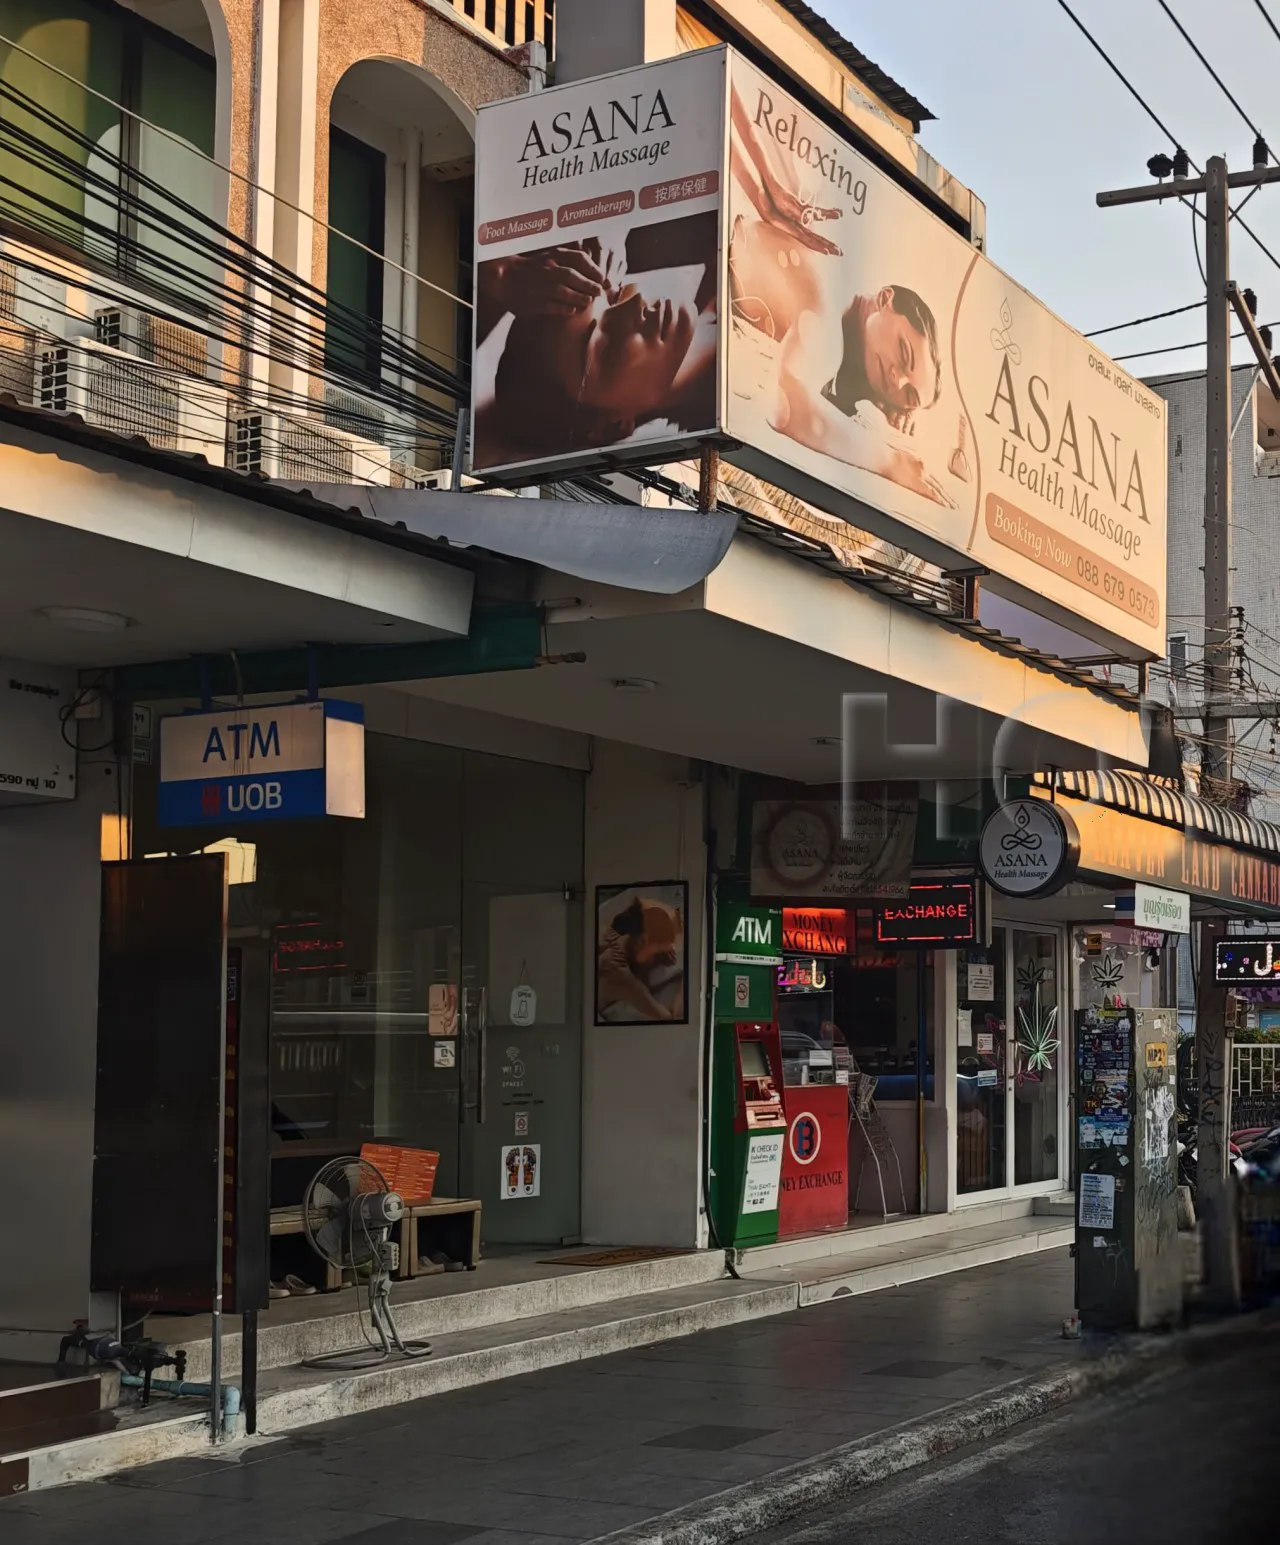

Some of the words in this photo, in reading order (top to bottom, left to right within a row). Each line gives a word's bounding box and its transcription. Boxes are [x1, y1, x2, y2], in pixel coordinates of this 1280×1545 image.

[517, 88, 677, 163] ASANA
[522, 154, 584, 188] Health
[590, 139, 670, 173] Massage
[753, 88, 870, 216] Relaxing
[654, 177, 708, 204] 按摩保健
[560, 196, 633, 224] Aromatherapy
[485, 224, 506, 240] Foot
[507, 214, 549, 237] Massage
[985, 353, 1152, 526] ASANA
[999, 438, 1065, 513] Health
[1071, 484, 1143, 560] Massage
[994, 505, 1043, 558] Booking
[1045, 536, 1073, 568] Now
[1076, 556, 1101, 587] 088
[1103, 568, 1126, 601] 679
[1129, 585, 1156, 619] 0573
[203, 721, 281, 763] ATM
[227, 781, 283, 812] UOB
[993, 853, 1049, 868] ASANA
[994, 869, 1018, 879] Health
[1018, 869, 1049, 880] Massage
[1181, 838, 1220, 892] LAND
[792, 913, 836, 933] MONEY
[884, 903, 968, 920] EXCHANGE
[731, 916, 772, 945] ATM
[756, 1144, 773, 1152] CHECK
[799, 1170, 843, 1190] EXCHANGE
